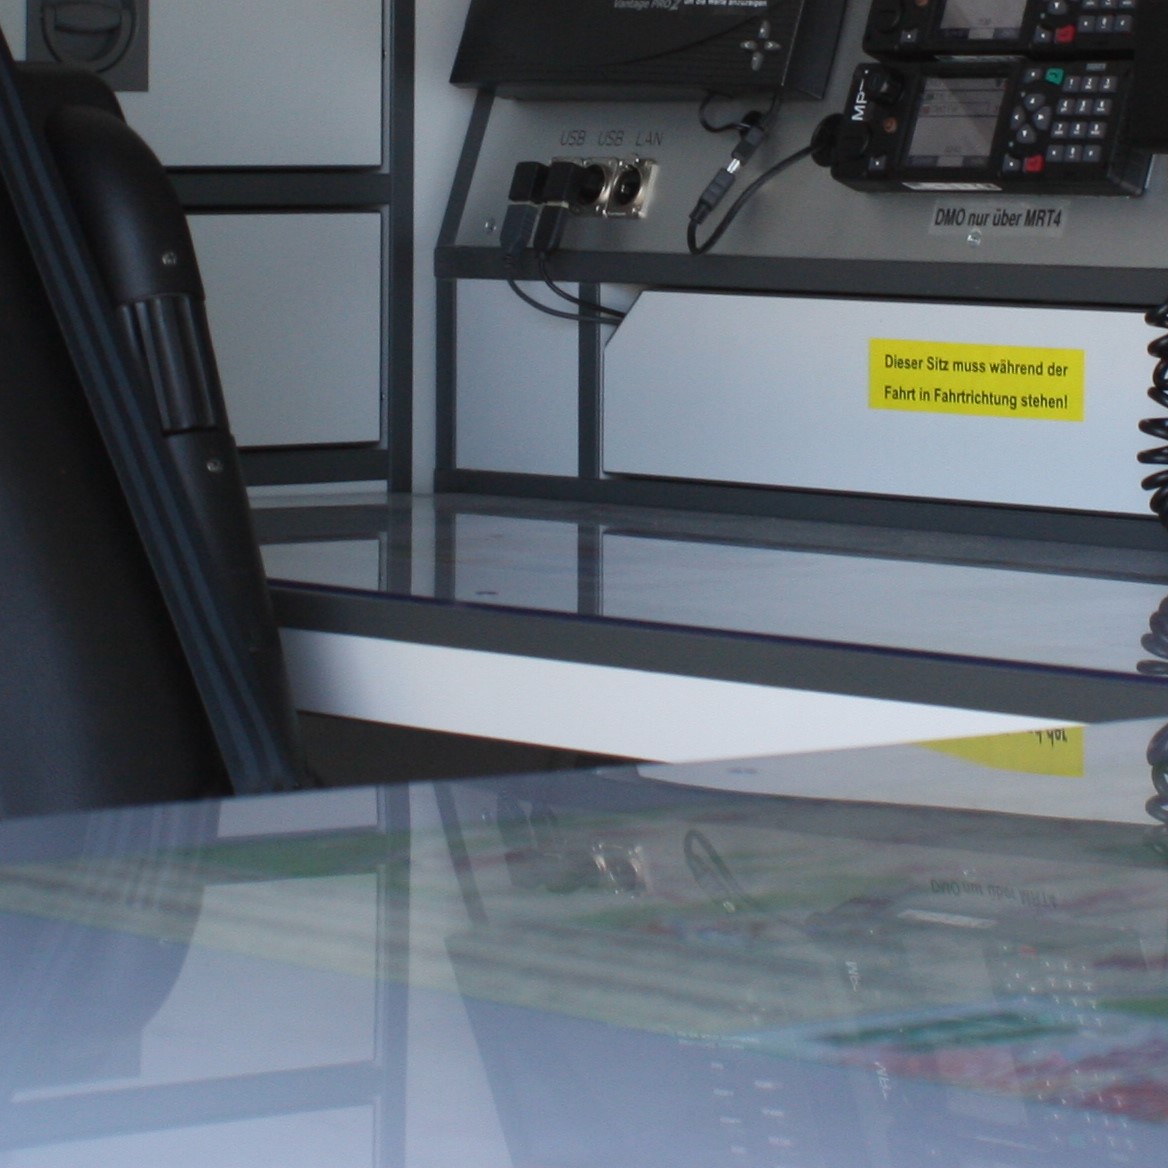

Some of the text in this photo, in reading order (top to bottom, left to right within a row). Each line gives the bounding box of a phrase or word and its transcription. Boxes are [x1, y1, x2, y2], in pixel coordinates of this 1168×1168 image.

[560, 130, 586, 146] USB
[597, 130, 624, 146] USB
[635, 131, 664, 147] LAN
[935, 208, 1063, 227] DMO nur über MRT4
[885, 354, 1069, 377] Dieser Sitz muss während der
[884, 385, 1069, 410] Fahrt in Fahrtrichtung stehen!
